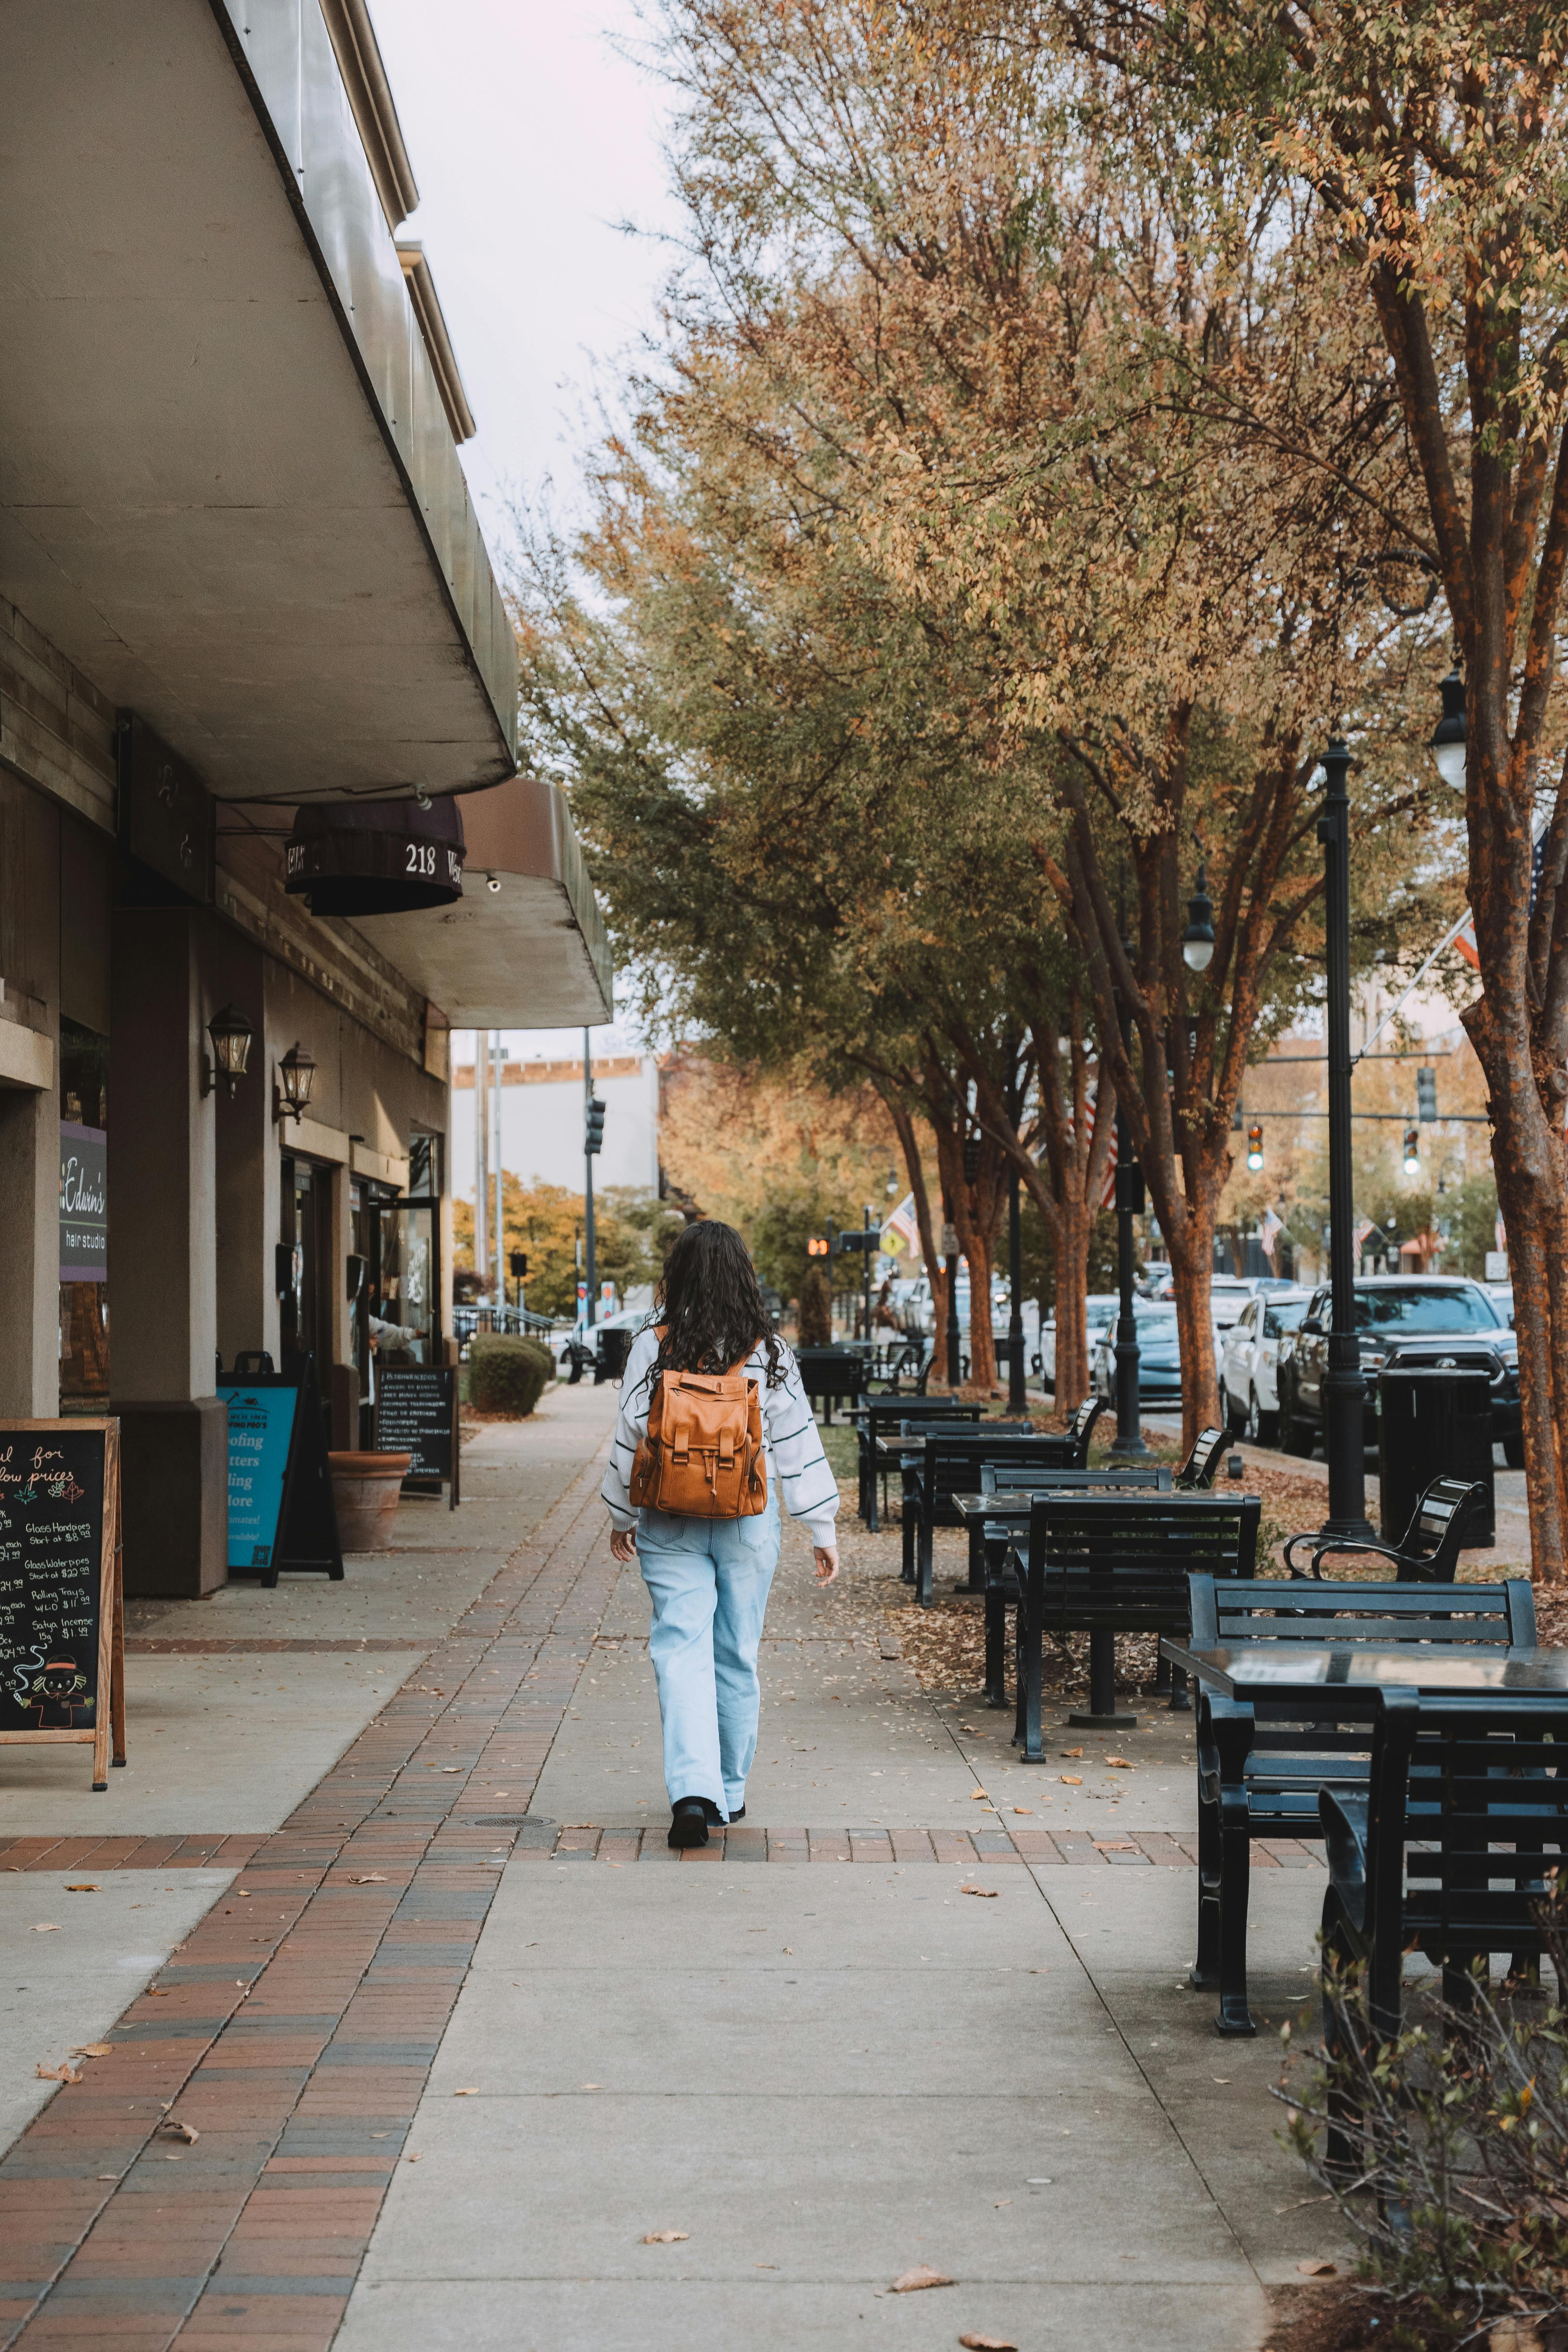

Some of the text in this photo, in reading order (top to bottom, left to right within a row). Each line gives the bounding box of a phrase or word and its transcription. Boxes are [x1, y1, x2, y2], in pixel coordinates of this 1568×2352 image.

[406, 844, 436, 875] 218
[65, 1157, 105, 1214] Edwin's
[66, 1230, 105, 1249] hair studio
[229, 1433, 263, 1450] ofing
[29, 1447, 64, 1469] for
[27, 1469, 74, 1491] prices
[25, 1522, 91, 1533] Glass Handpipes
[30, 1536, 50, 1545] Start
[65, 1530, 91, 1543] $8.99
[25, 1560, 46, 1569] Glass
[29, 1572, 49, 1580] Start
[62, 1567, 90, 1578] $22.99
[32, 1588, 84, 1602] Rolling Trays
[0, 1604, 11, 1615] mg
[32, 1618, 93, 1632] Satya Incense
[39, 1632, 52, 1643] 15g
